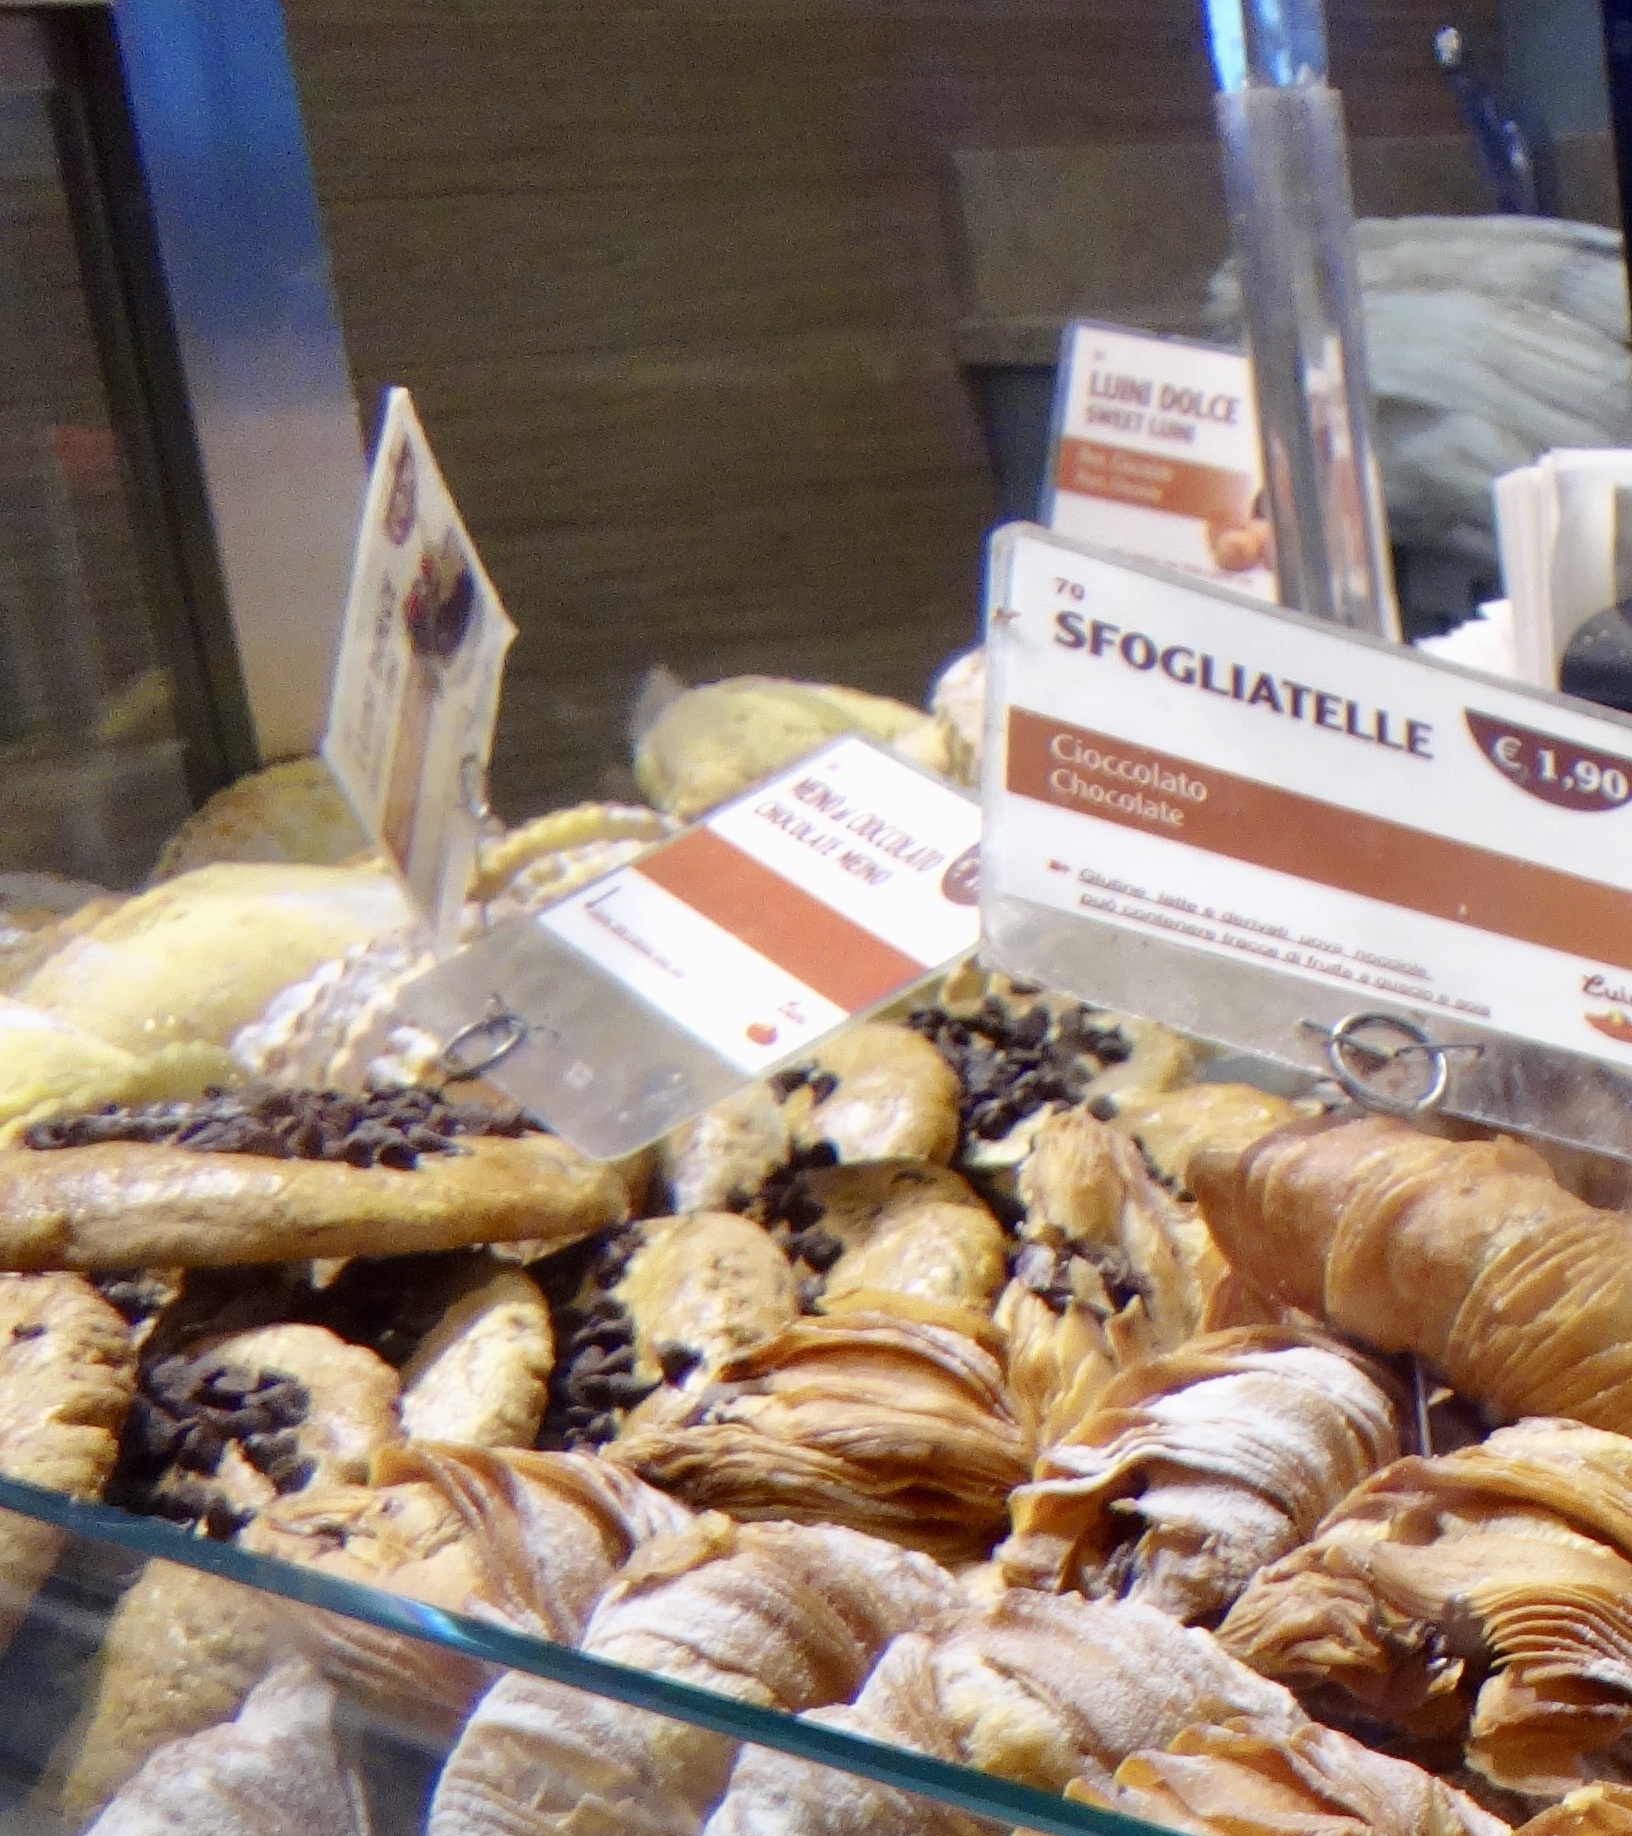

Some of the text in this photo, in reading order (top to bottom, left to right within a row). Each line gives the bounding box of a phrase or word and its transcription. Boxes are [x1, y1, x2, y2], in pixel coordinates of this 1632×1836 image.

[1159, 381, 1242, 425] DOLCE
[1052, 608, 1435, 760] SFOGLIATELLE
[1049, 732, 1208, 803] Cioccolato
[1049, 768, 1186, 828] Chocolate
[1494, 735, 1631, 801] € 1,90
